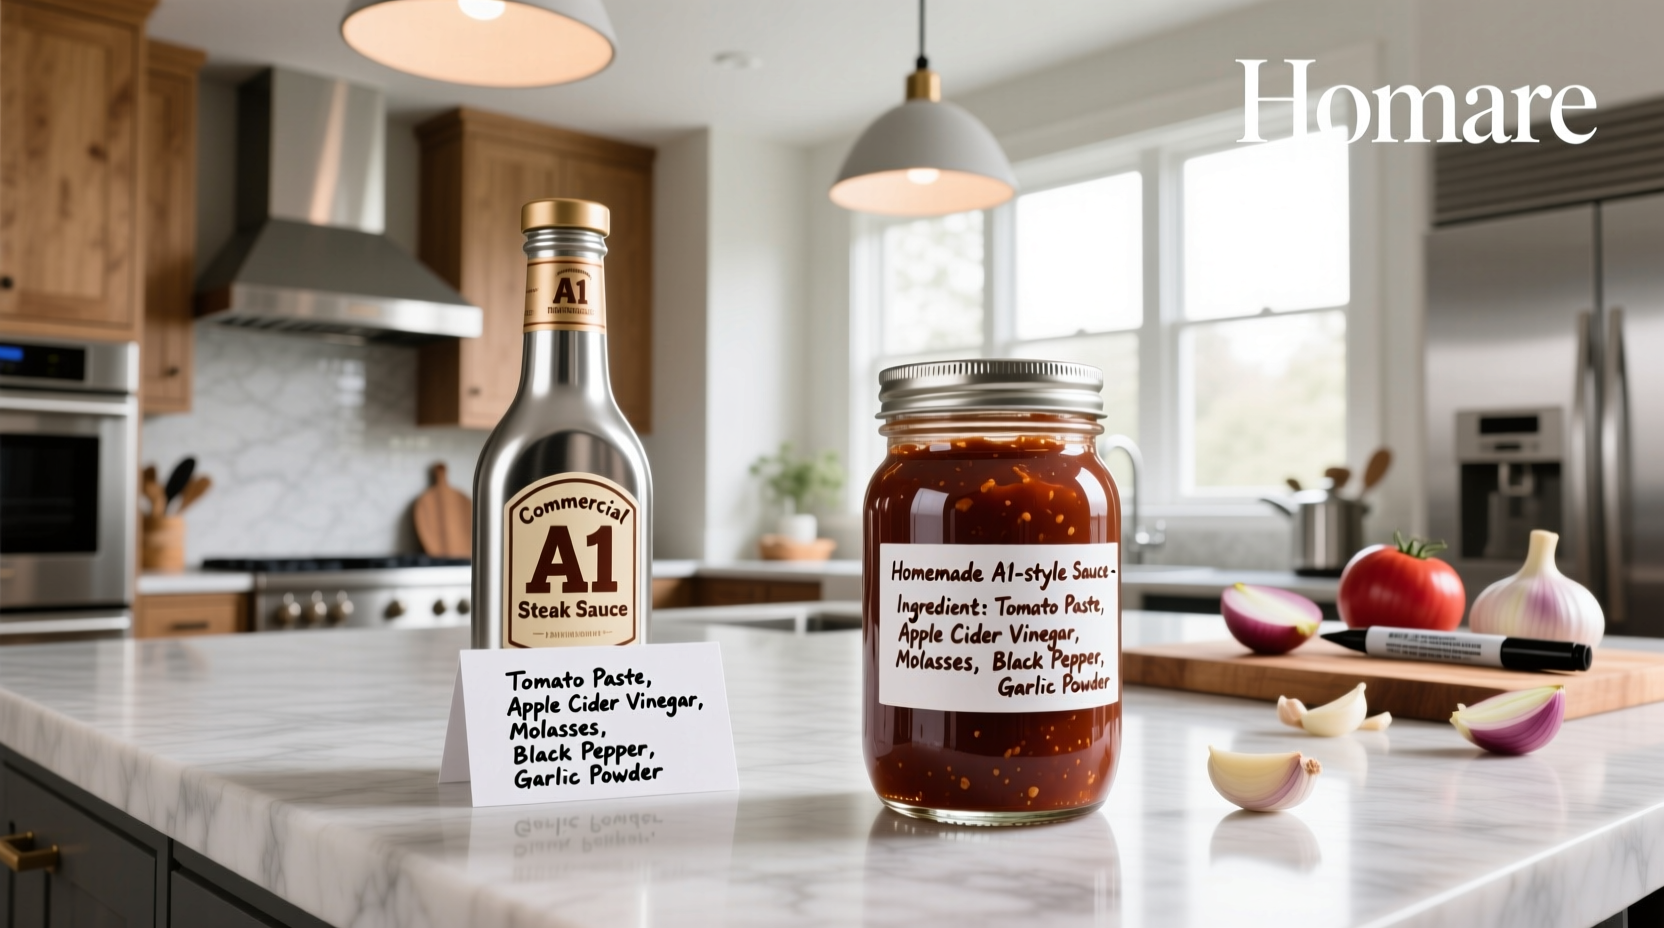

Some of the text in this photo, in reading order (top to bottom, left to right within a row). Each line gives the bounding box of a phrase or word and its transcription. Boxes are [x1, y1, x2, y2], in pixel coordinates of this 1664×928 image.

[552, 277, 588, 305] A1
[519, 496, 631, 525] Commercial
[525, 525, 618, 594] A1
[891, 560, 984, 583] Homemade
[518, 600, 628, 619] Steak Sauce
[897, 593, 1105, 624] Ingredient: Tomato Paste,
[898, 621, 1080, 651] Apple Cider Vinegar,
[895, 648, 1105, 675] Molasses, Black Pepper,
[505, 667, 652, 692] Tomato Paste,
[997, 672, 1111, 698] Garlic Powder
[507, 692, 704, 722] Apple Cider Vinegar,
[509, 720, 606, 741] Molasses,
[513, 741, 655, 766] Black Pepper,
[514, 763, 664, 790] Garlic Powder
